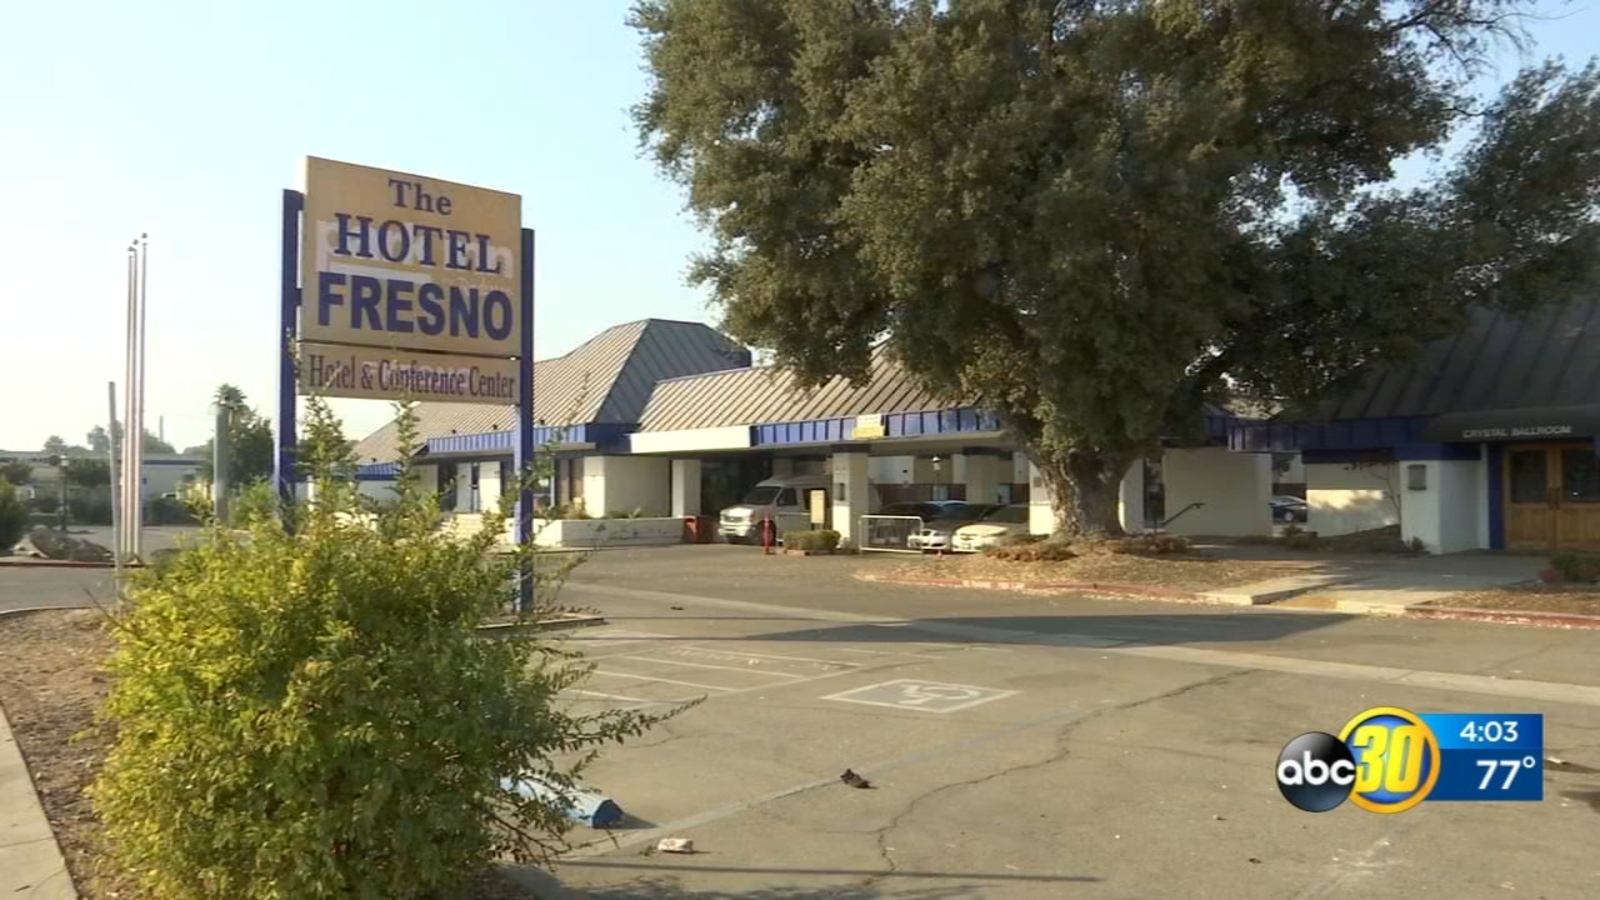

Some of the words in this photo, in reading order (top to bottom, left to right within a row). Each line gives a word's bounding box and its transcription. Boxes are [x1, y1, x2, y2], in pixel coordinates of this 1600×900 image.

[388, 178, 452, 215] The
[334, 212, 501, 274] HOTEL
[317, 271, 513, 341] FRESNO
[308, 354, 356, 390] Hotel
[360, 364, 374, 391] &
[378, 358, 465, 397] Conference
[469, 366, 516, 399] Center
[1511, 425, 1572, 436] BALLROOM
